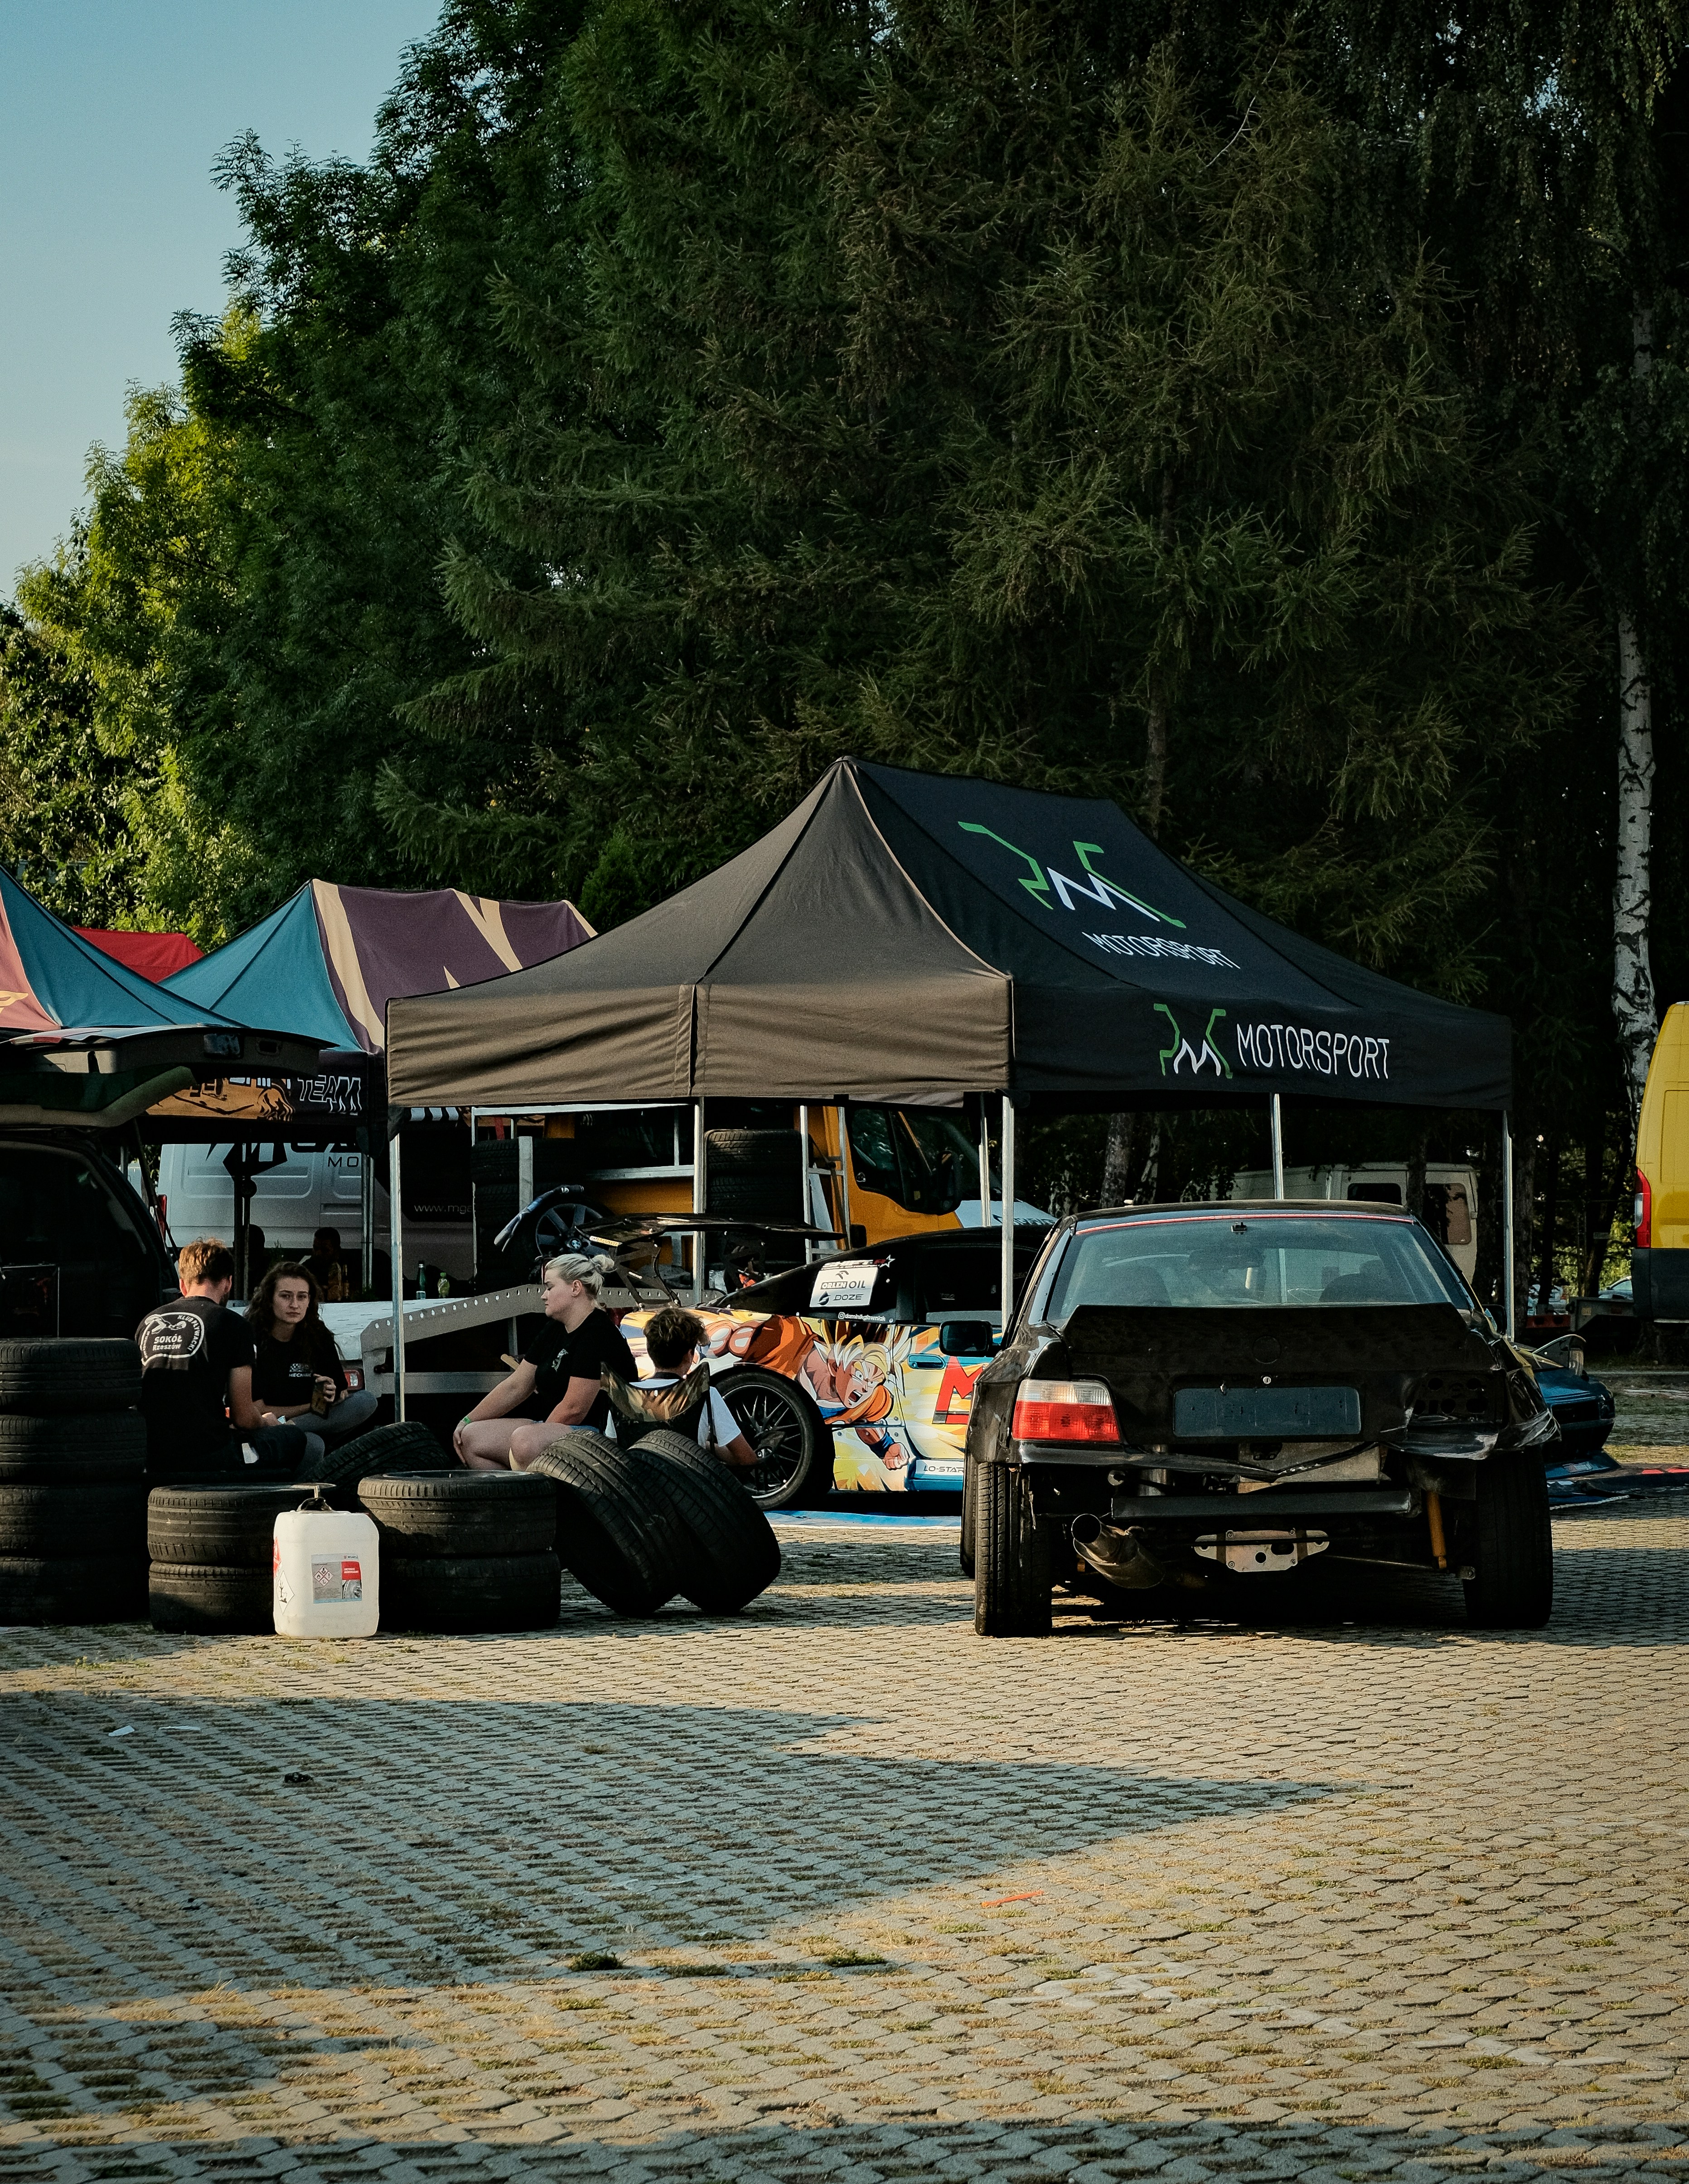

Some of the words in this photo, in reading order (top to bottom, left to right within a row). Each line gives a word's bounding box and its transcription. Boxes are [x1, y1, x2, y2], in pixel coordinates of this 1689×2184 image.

[1082, 932, 1241, 969] MOTORSPORT
[1237, 1024, 1389, 1078] MOTORSPORT
[297, 1075, 362, 1115] TEAM
[152, 1343, 181, 1351] Rzeszów
[154, 1334, 182, 1343] SOKÓŁ
[923, 1465, 964, 1473] LO-STAR
